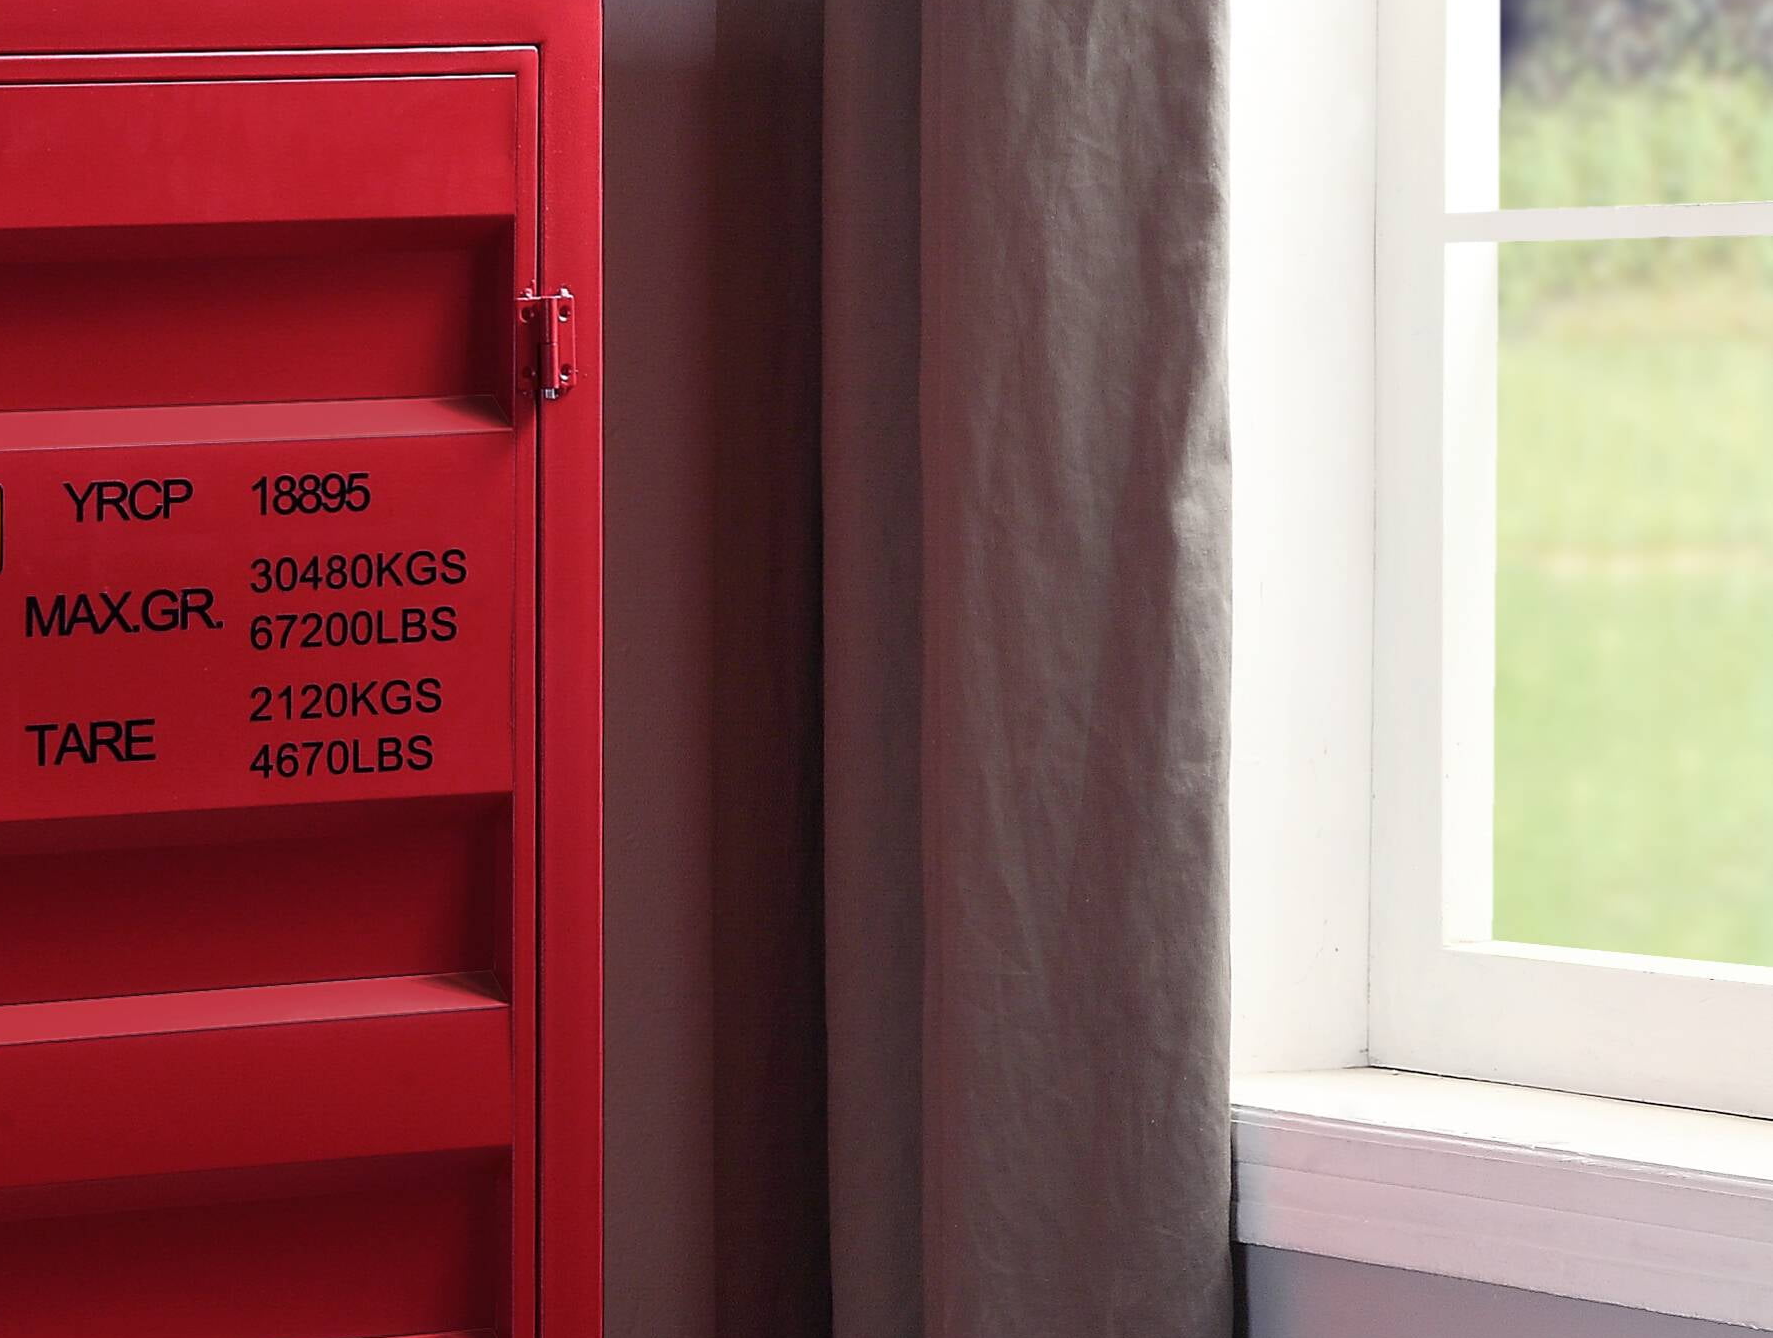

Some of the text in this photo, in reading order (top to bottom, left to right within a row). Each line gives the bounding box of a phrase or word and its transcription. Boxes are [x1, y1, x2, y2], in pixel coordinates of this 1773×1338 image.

[63, 472, 371, 523] YRCP 18895
[250, 549, 467, 594] 30480KGS
[25, 587, 224, 638] MAX.GR.
[250, 606, 457, 651] 67200LBS
[249, 677, 442, 722] 2120KGS
[24, 718, 157, 767] TARE
[249, 734, 433, 779] 4670LBS
